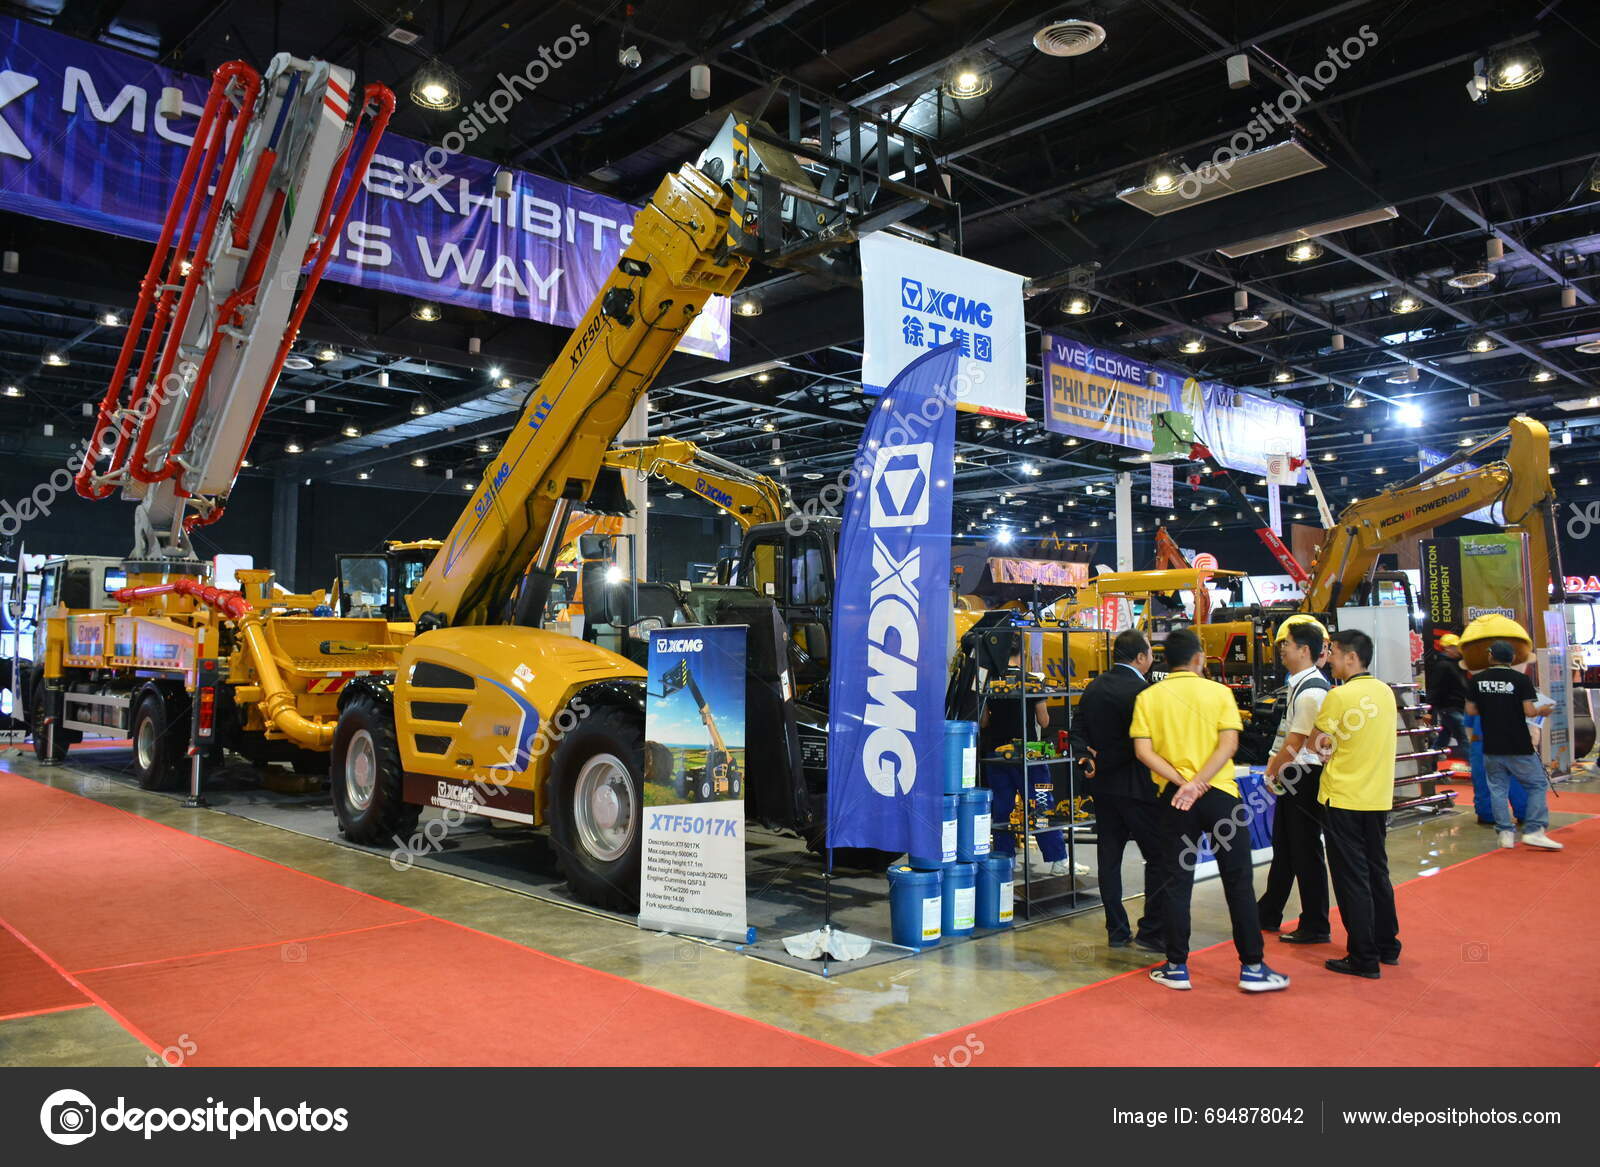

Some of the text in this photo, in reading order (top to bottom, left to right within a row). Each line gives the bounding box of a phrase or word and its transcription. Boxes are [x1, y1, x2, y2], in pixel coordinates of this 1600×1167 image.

[415, 235, 564, 300] WAY
[923, 287, 993, 329] XCMG
[903, 314, 993, 362] 徐工集团
[1057, 344, 1141, 381] WELCOME
[705, 484, 733, 507] XCMG
[1415, 487, 1470, 515] POWERQUIP
[1428, 545, 1441, 623] CONSTRUCTION
[1440, 565, 1452, 623] EQUIPMENT
[667, 639, 704, 653] XCMG
[862, 532, 921, 797] XCMG
[649, 813, 737, 838] XTF5017K
